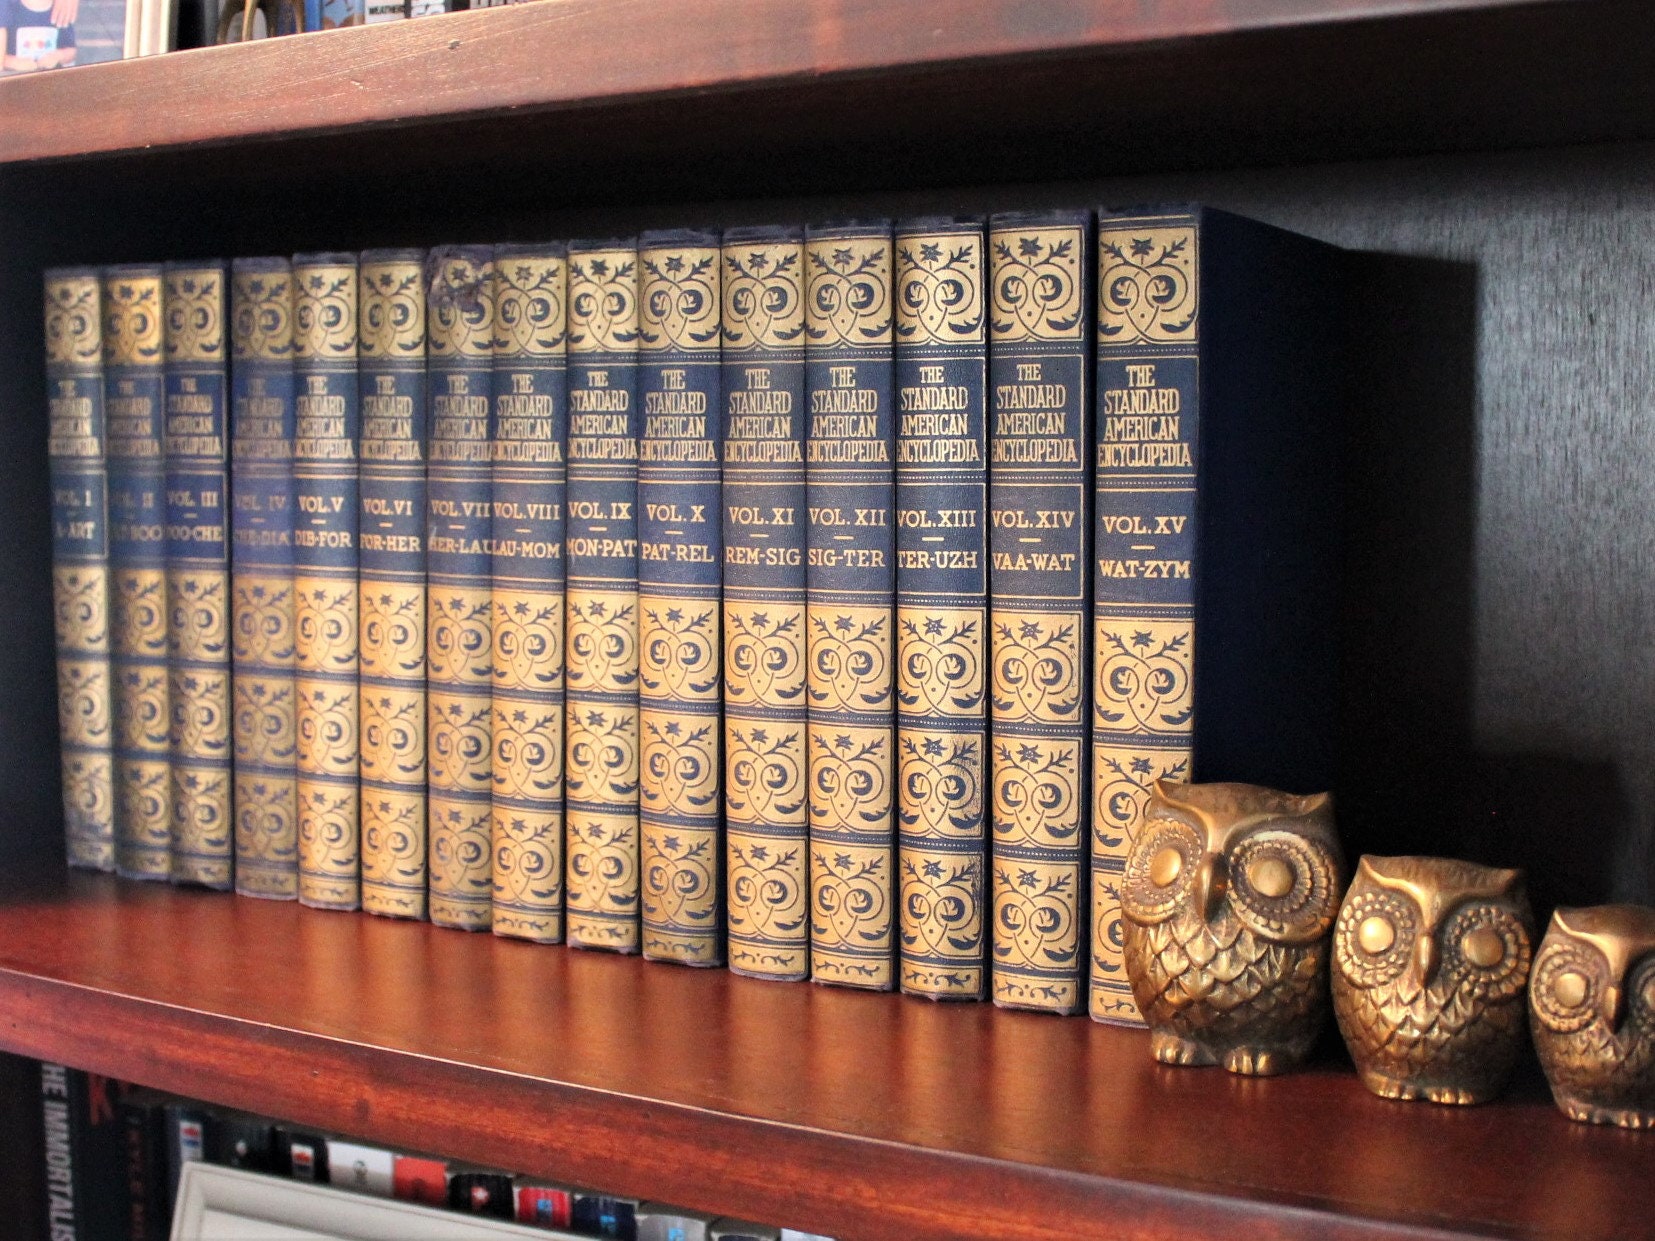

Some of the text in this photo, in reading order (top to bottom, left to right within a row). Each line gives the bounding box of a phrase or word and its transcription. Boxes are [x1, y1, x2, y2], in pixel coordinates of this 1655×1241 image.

[511, 373, 534, 394] THE
[587, 370, 609, 387] THE
[661, 369, 686, 390] THE
[745, 368, 771, 389] THE
[829, 366, 856, 387] THE
[919, 366, 945, 384] THE
[1016, 364, 1042, 381] THE
[1125, 364, 1156, 387] THE
[497, 395, 553, 417] STANDARD
[570, 390, 629, 411] STANDARD
[645, 392, 706, 414] STANDARD
[729, 391, 792, 414] STANDARD
[811, 390, 878, 413] STANDARD
[901, 387, 969, 410] STANDARD
[996, 385, 1066, 409] STANDARD
[1104, 388, 1180, 415] STANDARD
[496, 418, 552, 440] AMERICAN
[570, 415, 629, 435] AMERICAN
[645, 416, 706, 438] AMERICAN
[729, 416, 792, 438] AMERICAN
[811, 416, 878, 438] AMERICAN
[901, 413, 968, 436] AMERICAN
[996, 412, 1066, 435] AMERICAN
[1103, 416, 1180, 441] AMERICAN
[640, 440, 717, 462] ENCYCLOPEDIA
[724, 440, 803, 463] ENCYCLOPEDIA
[806, 440, 889, 462] ENCYCLOPEDIA
[898, 439, 980, 462] ENCYCLOPEDIA
[991, 438, 1078, 463] ENCYCLOPEDIA
[1097, 443, 1193, 468] ENCYCLOPEDIA
[492, 539, 560, 558] LAU-MOM
[641, 544, 714, 563] PAT-REL
[726, 546, 801, 565] REM-SIG
[808, 548, 886, 568] SIG-TER
[898, 551, 978, 569] TER-UZH
[992, 553, 1076, 571] VAA-WAT
[1099, 560, 1191, 579] WAT-ZYM
[42, 1064, 67, 1097] HE
